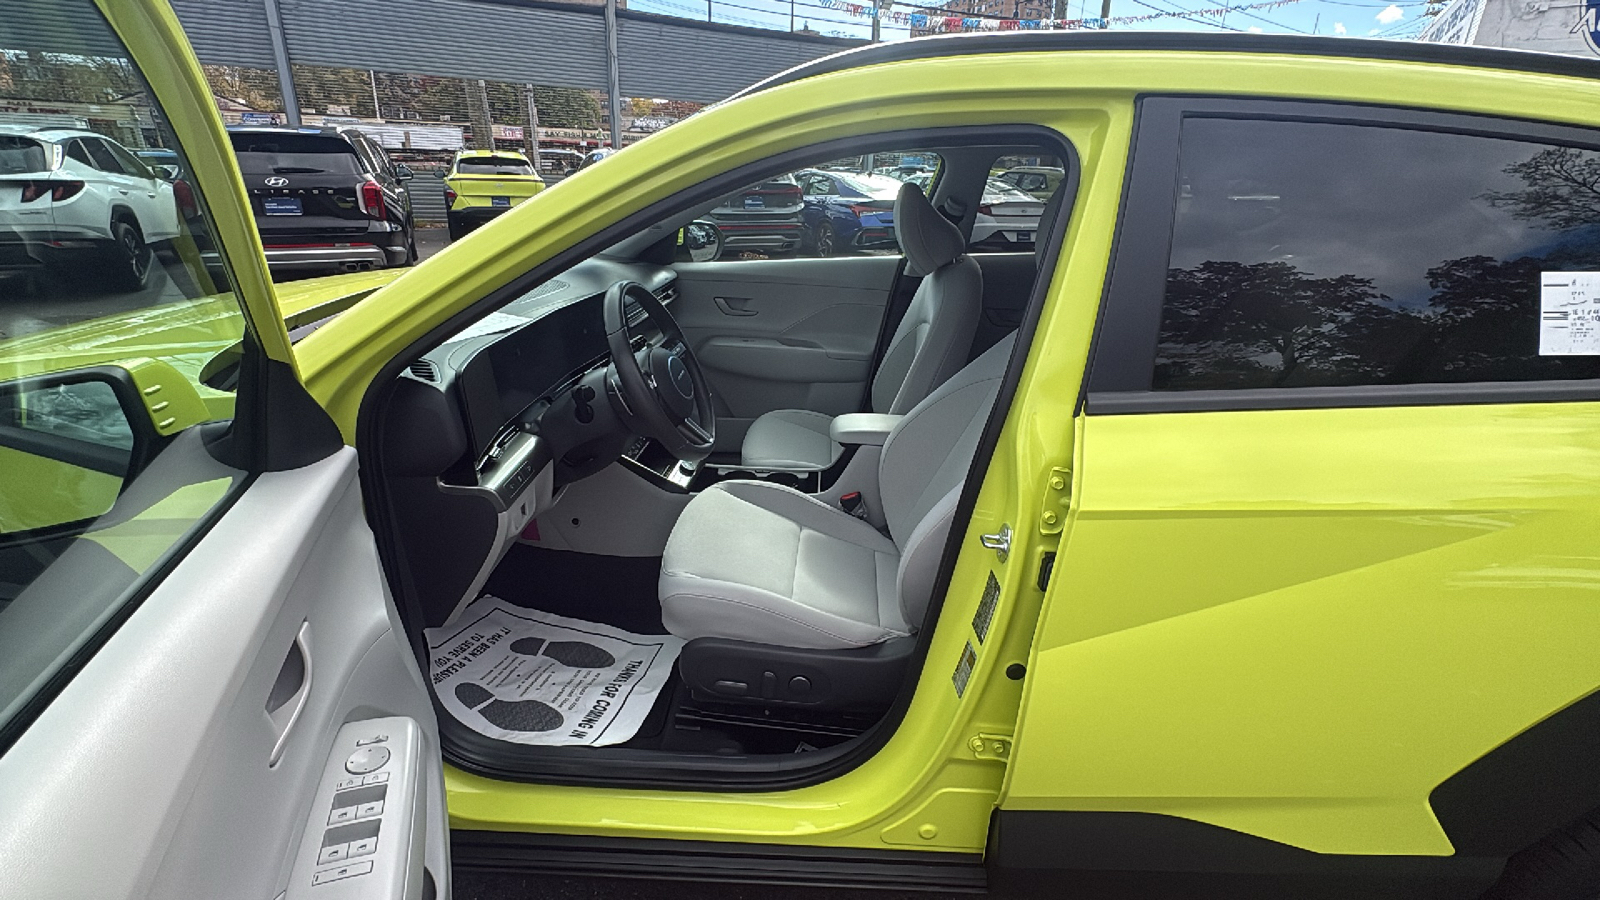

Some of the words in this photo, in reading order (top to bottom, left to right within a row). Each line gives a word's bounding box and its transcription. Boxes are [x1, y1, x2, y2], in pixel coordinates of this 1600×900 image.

[470, 632, 485, 642] TO
[486, 632, 504, 645] HAS
[448, 640, 474, 658] SERVE
[468, 642, 491, 658] BEEN
[434, 656, 453, 668] YOU
[613, 660, 643, 683] THANKS
[600, 682, 622, 699] FOR
[578, 699, 611, 729] COMING
[568, 729, 588, 739] IN
